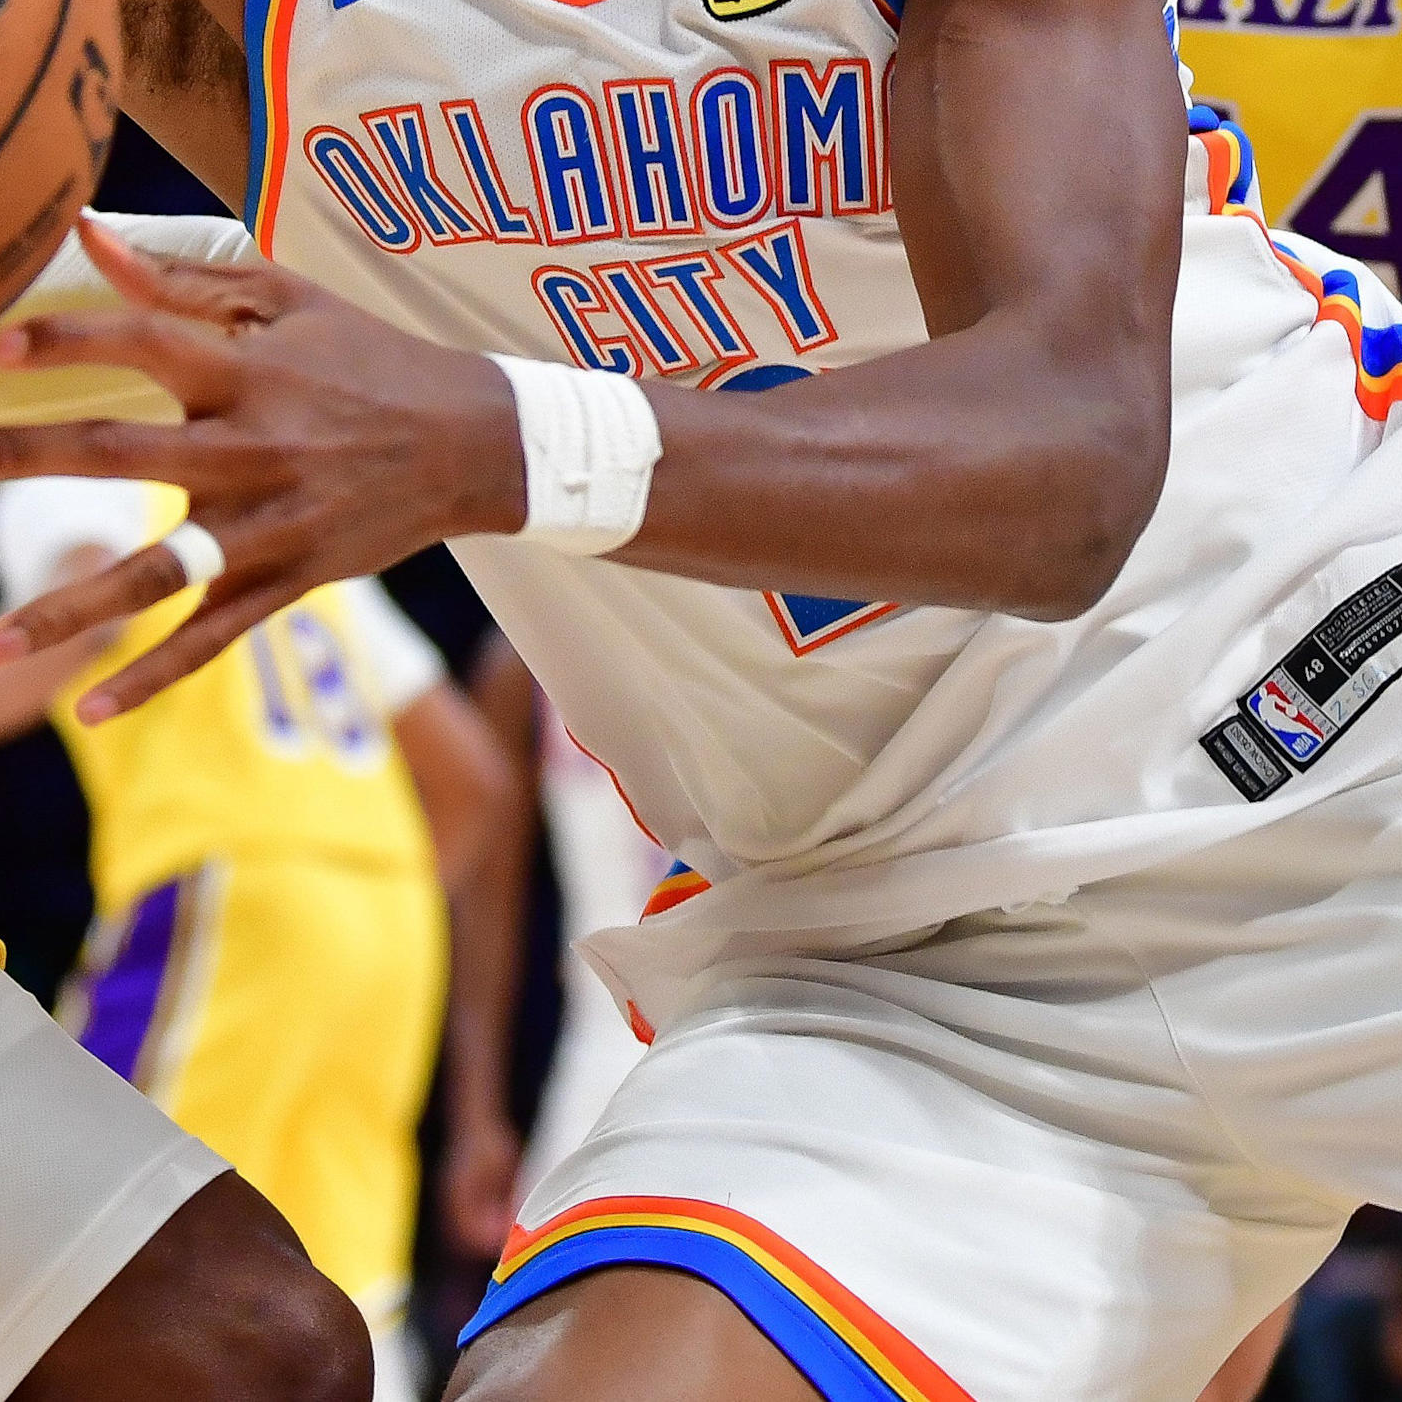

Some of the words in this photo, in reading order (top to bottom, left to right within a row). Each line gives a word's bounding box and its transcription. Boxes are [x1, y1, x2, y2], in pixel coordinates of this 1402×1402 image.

[304, 58, 896, 255] OKLAHOM
[531, 217, 839, 376] CITY
[1304, 658, 1325, 683] 48
[1290, 734, 1314, 755] NBA
